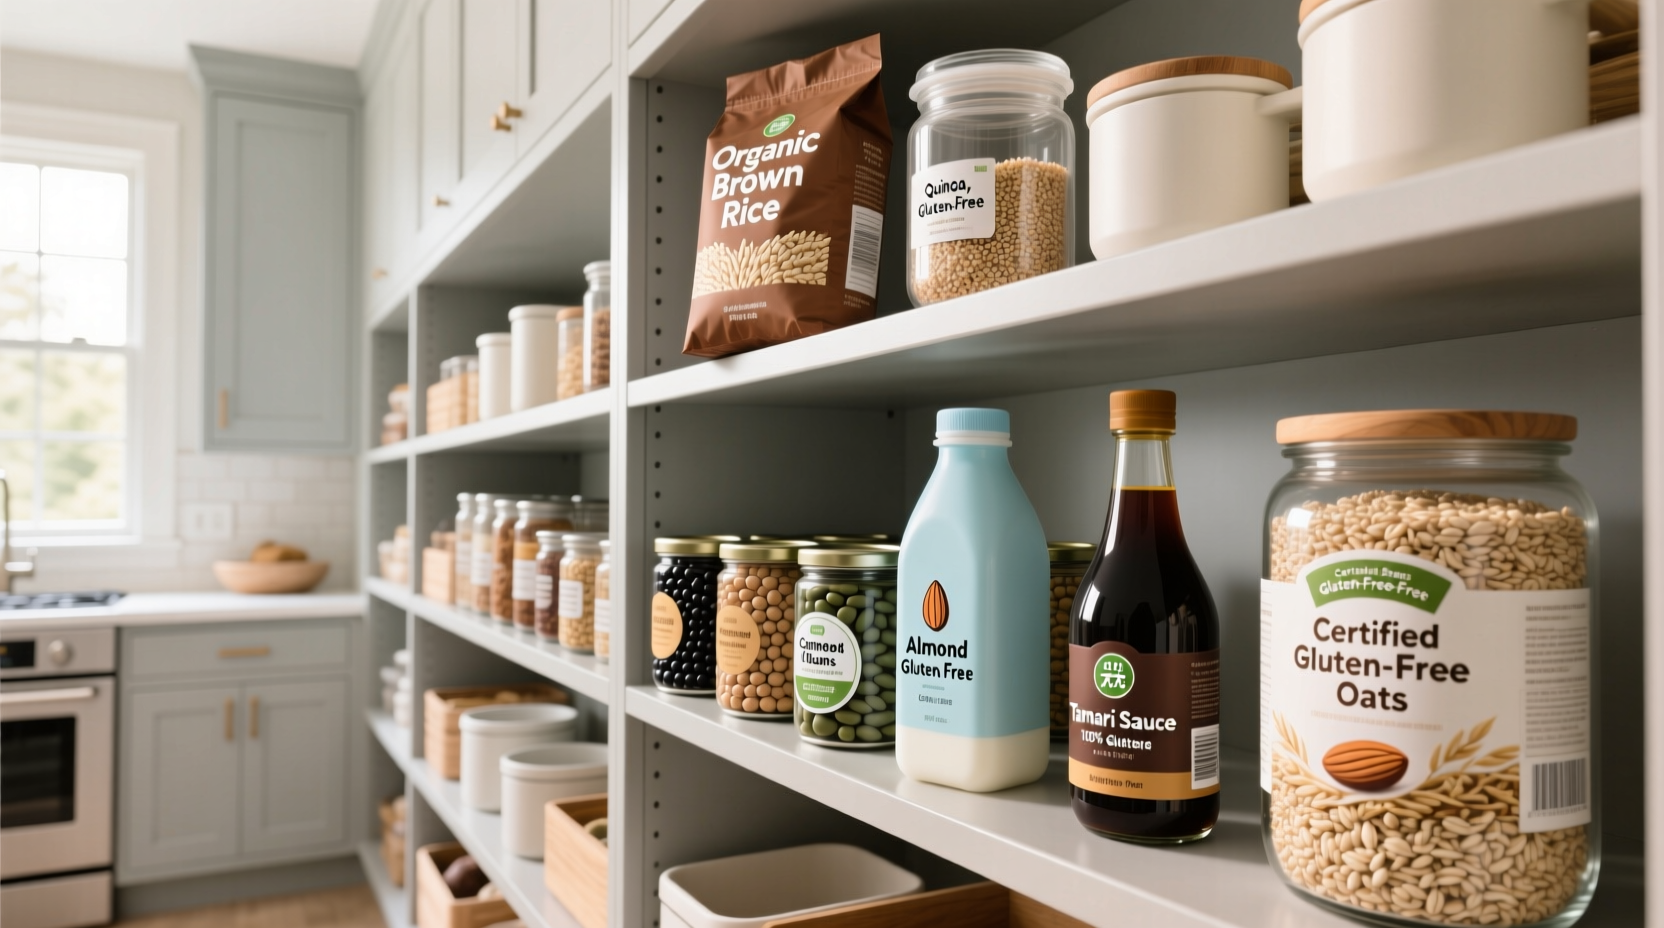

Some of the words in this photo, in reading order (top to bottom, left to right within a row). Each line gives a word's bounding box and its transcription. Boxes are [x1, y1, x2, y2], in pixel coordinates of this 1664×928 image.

[712, 129, 821, 173] Organic
[711, 164, 804, 201] Brown
[924, 179, 971, 198] Quinoa,
[721, 197, 780, 229] Rice
[906, 635, 968, 659] Almond
[1313, 616, 1440, 650] Certified
[901, 658, 941, 678] Gluten
[944, 662, 974, 681] Free
[1294, 644, 1470, 684] Gluten-Free
[1336, 681, 1409, 713] Oats
[1119, 710, 1178, 732] Sauce
